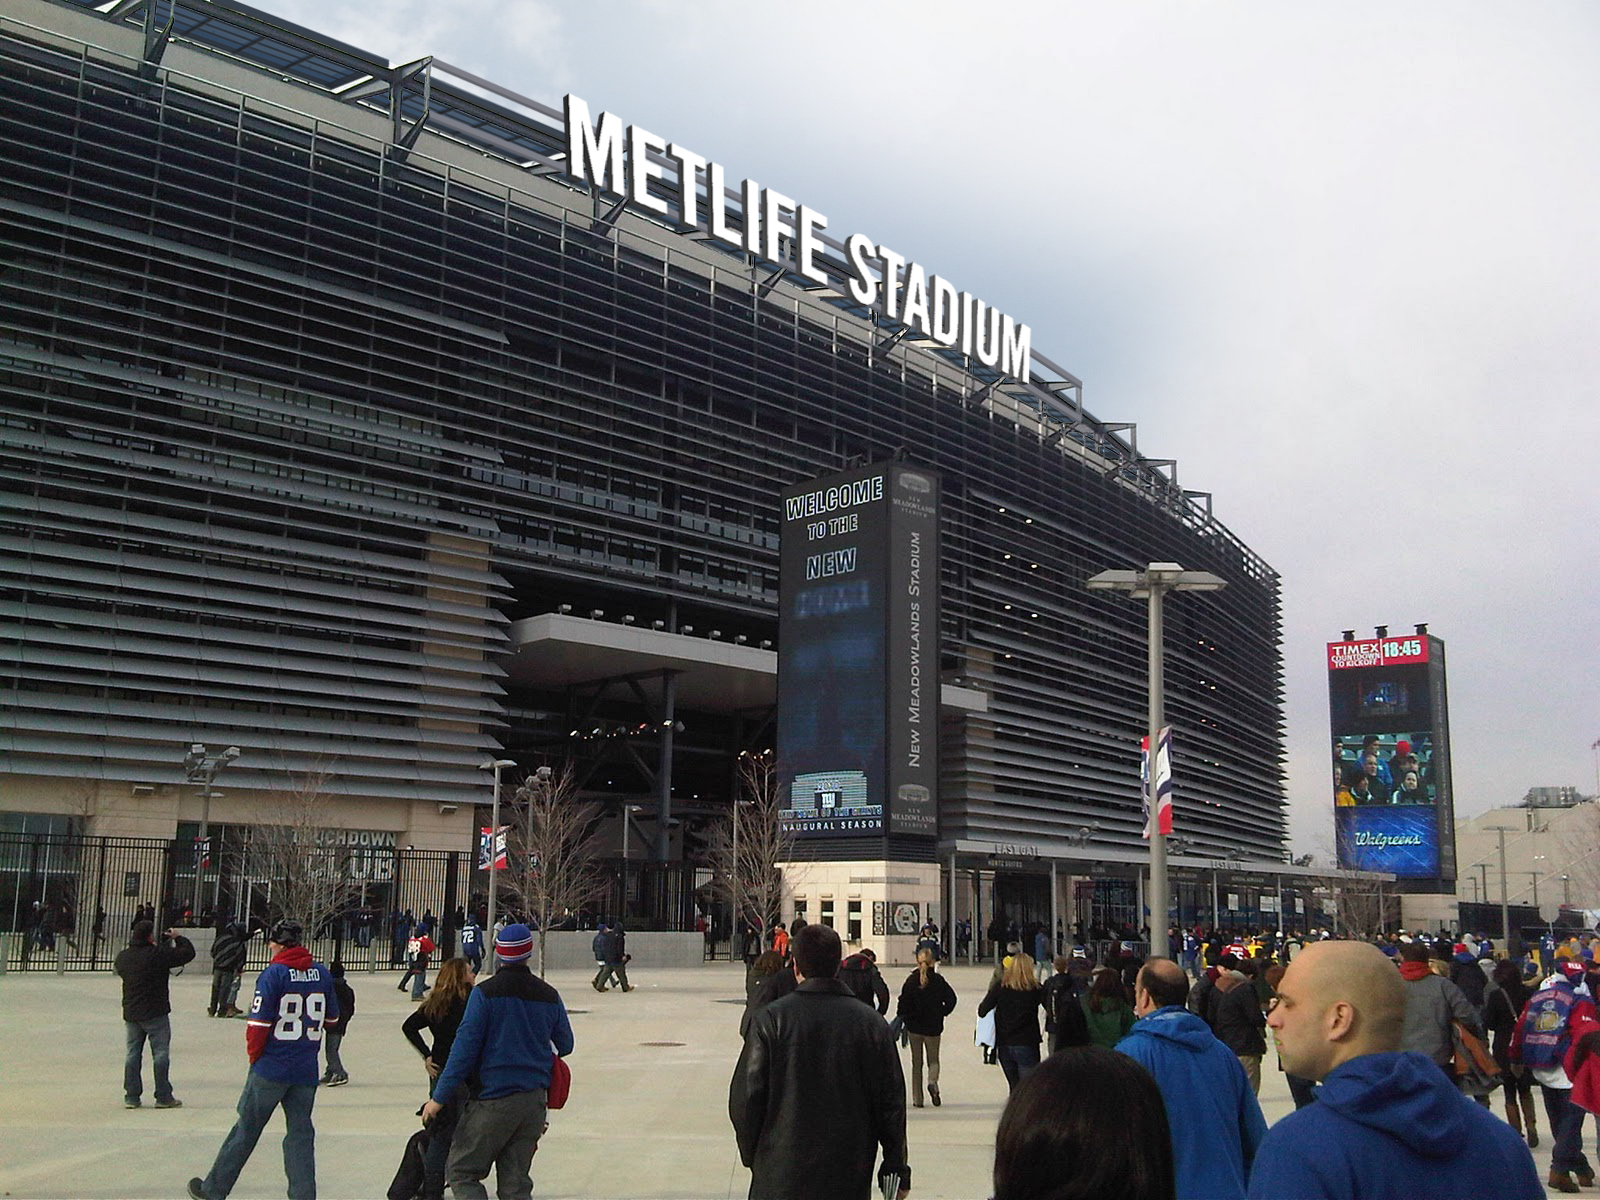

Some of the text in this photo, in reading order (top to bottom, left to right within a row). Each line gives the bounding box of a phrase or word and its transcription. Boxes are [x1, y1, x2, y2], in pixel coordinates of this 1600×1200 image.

[563, 93, 1031, 384] METLIFE STADIUM
[786, 476, 883, 521] WELCOME
[807, 513, 858, 541] TO THE
[806, 547, 857, 580] NEW
[908, 532, 920, 768] NEW MEADOWLANDS STADIUM
[1331, 653, 1380, 663] COUNTDOWN
[1332, 640, 1421, 657] TIMEX 18:45
[1334, 658, 1377, 668] TO KICKOFF
[840, 820, 882, 829] SEASON
[292, 828, 396, 848] TUCHDOWN
[1355, 831, 1421, 850] Walgreens
[462, 931, 474, 943] 72
[274, 993, 326, 1041] 89
